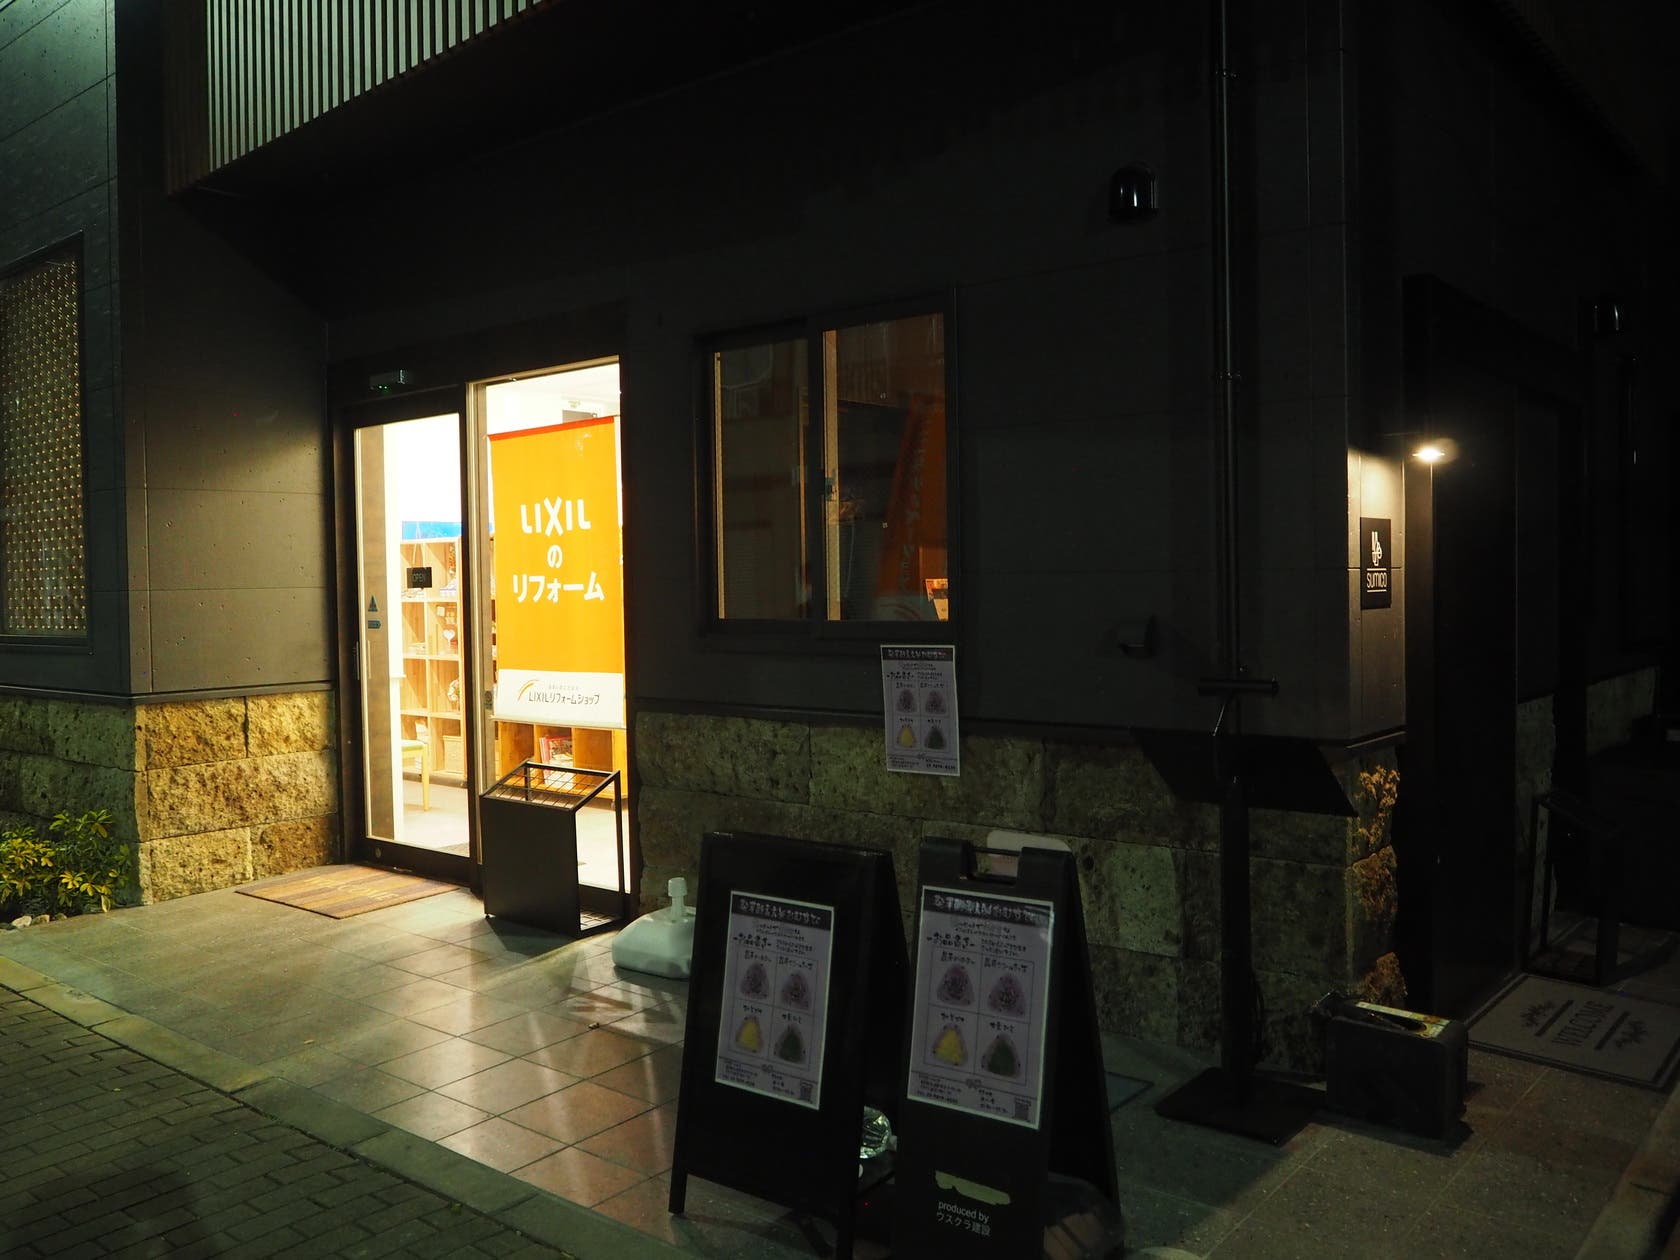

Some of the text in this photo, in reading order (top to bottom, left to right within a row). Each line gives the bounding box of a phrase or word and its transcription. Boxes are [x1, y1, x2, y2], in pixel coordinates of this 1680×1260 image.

[520, 496, 591, 537] LIXIL
[547, 544, 563, 568] の
[512, 571, 605, 603] リフォーム
[528, 691, 600, 705] LIXILリフォームショップ
[938, 1201, 990, 1224] produced by
